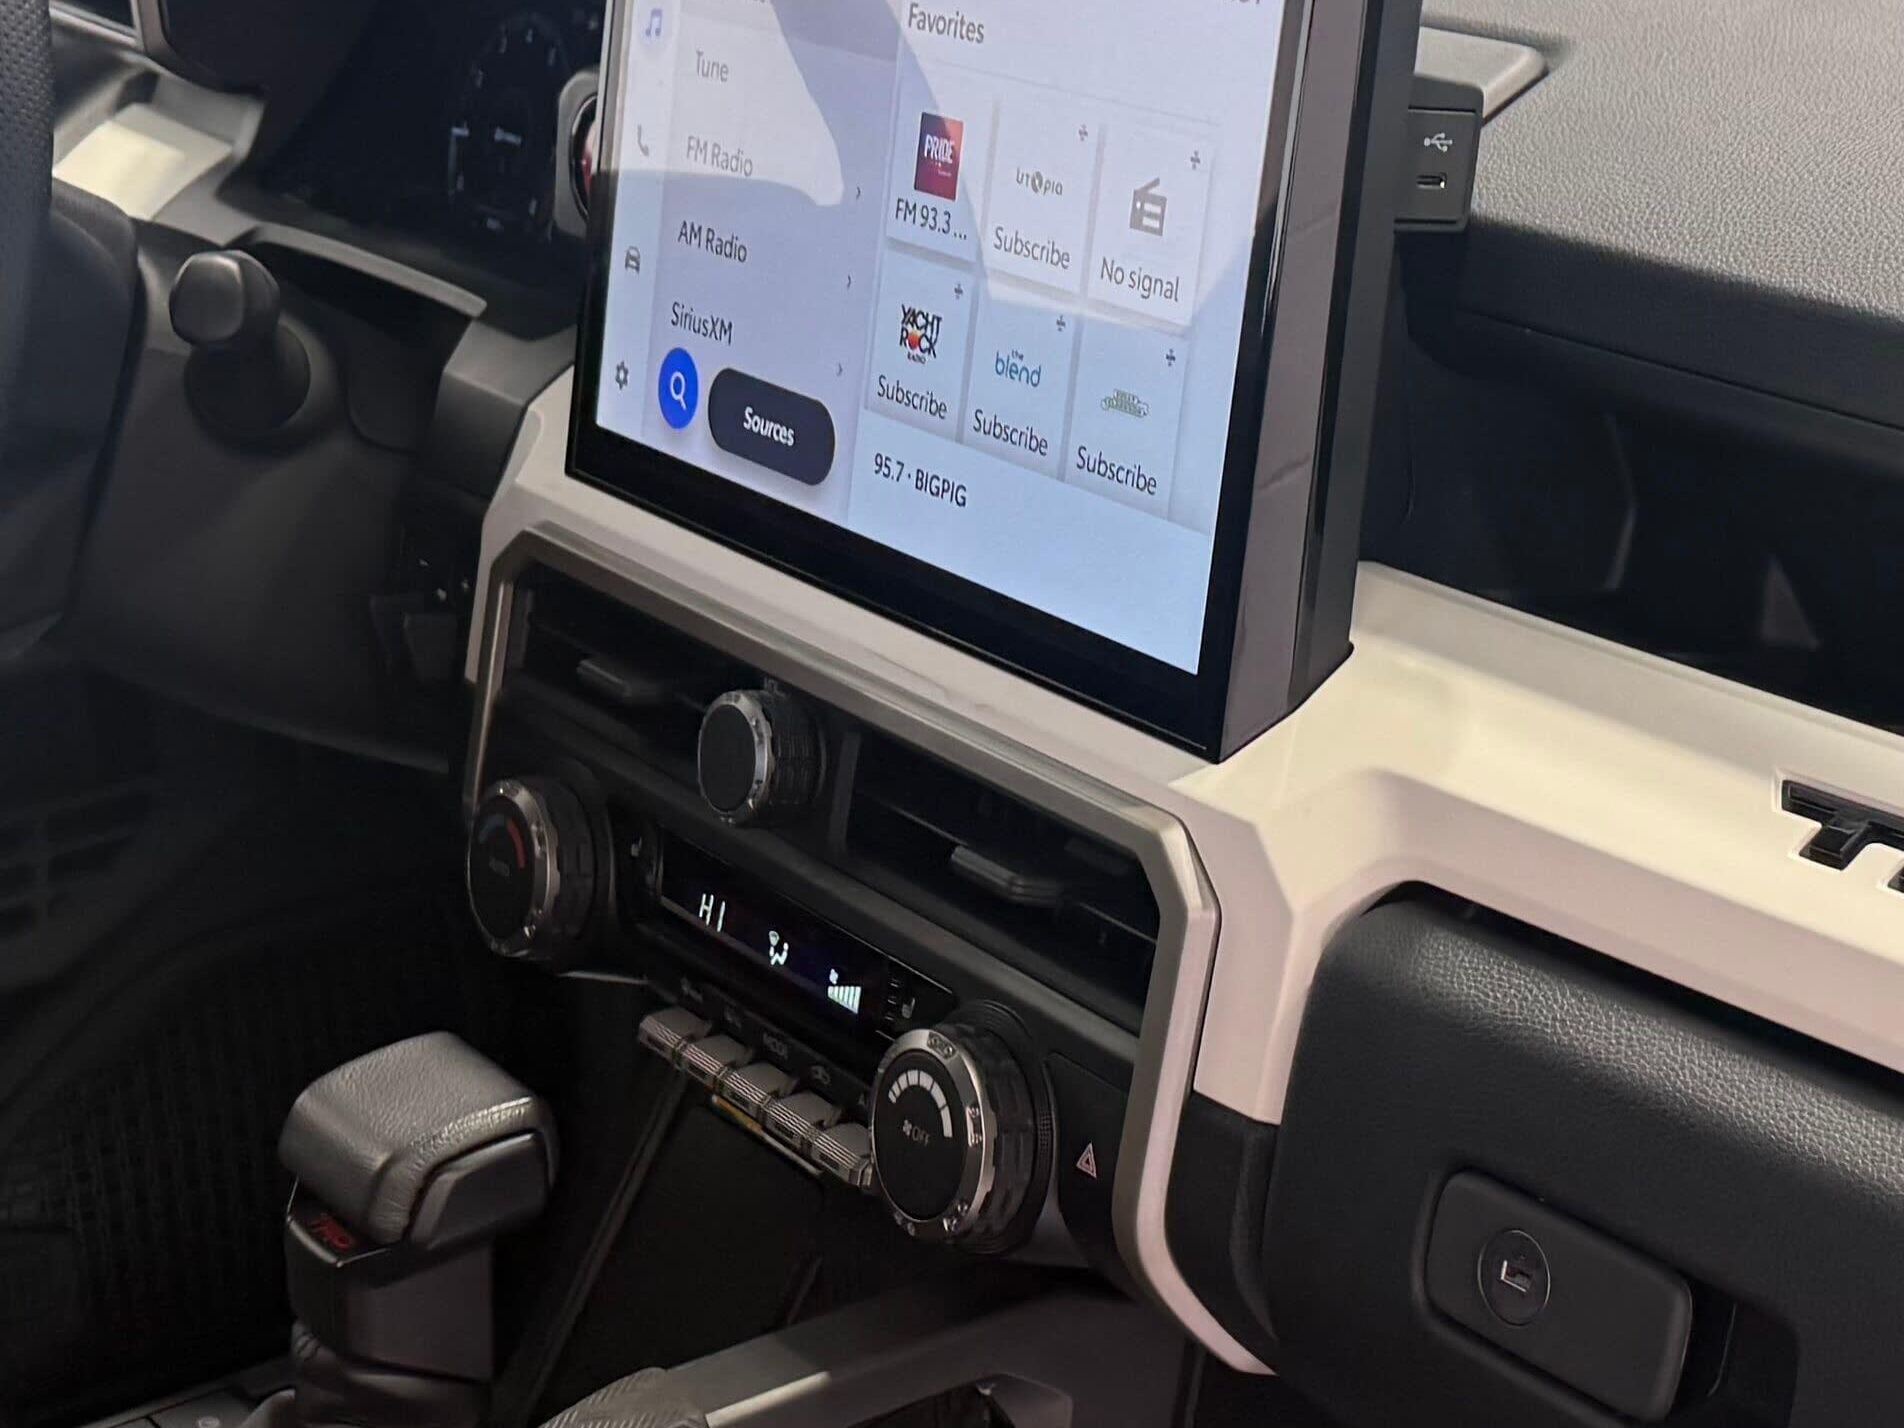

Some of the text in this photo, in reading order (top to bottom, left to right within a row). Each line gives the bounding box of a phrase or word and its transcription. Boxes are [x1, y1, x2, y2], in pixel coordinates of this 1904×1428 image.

[908, 2, 985, 44] Favorites
[695, 49, 730, 83] Tune
[686, 135, 753, 178] FM Radio
[923, 132, 955, 166] PRIDE
[896, 197, 917, 225] FM
[919, 205, 952, 236] 93.3
[677, 220, 748, 263] AM Radio
[994, 225, 1071, 270] Subscribe
[1100, 256, 1180, 302] No signal
[671, 300, 733, 346] SiriusXM
[901, 303, 942, 344] YACHT
[995, 351, 1041, 387] blend
[877, 374, 948, 420] Subscribe
[743, 406, 795, 447] Sources
[973, 408, 1049, 457] Subscribe
[874, 452, 967, 508] 95.7 BIGPIG
[1076, 446, 1158, 496] Subscribe
[699, 893, 726, 932] HI
